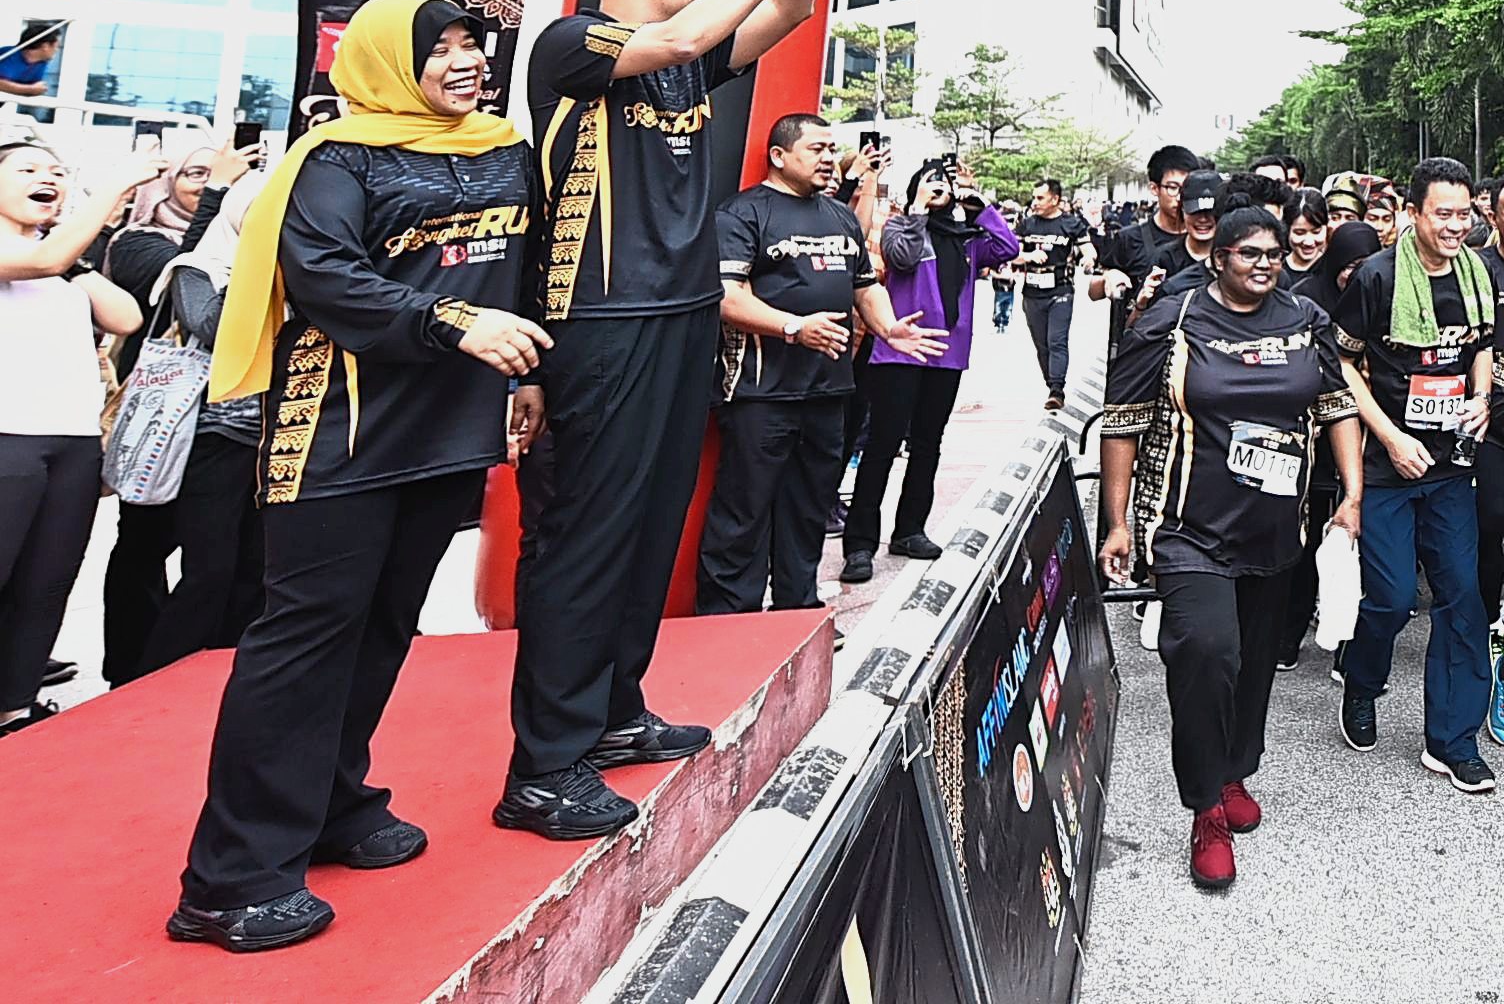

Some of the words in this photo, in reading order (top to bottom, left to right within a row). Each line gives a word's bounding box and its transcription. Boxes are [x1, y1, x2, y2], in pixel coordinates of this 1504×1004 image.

[466, 237, 508, 254] msu
[1411, 398, 1461, 415] S0137
[1232, 445, 1298, 479] M0116
